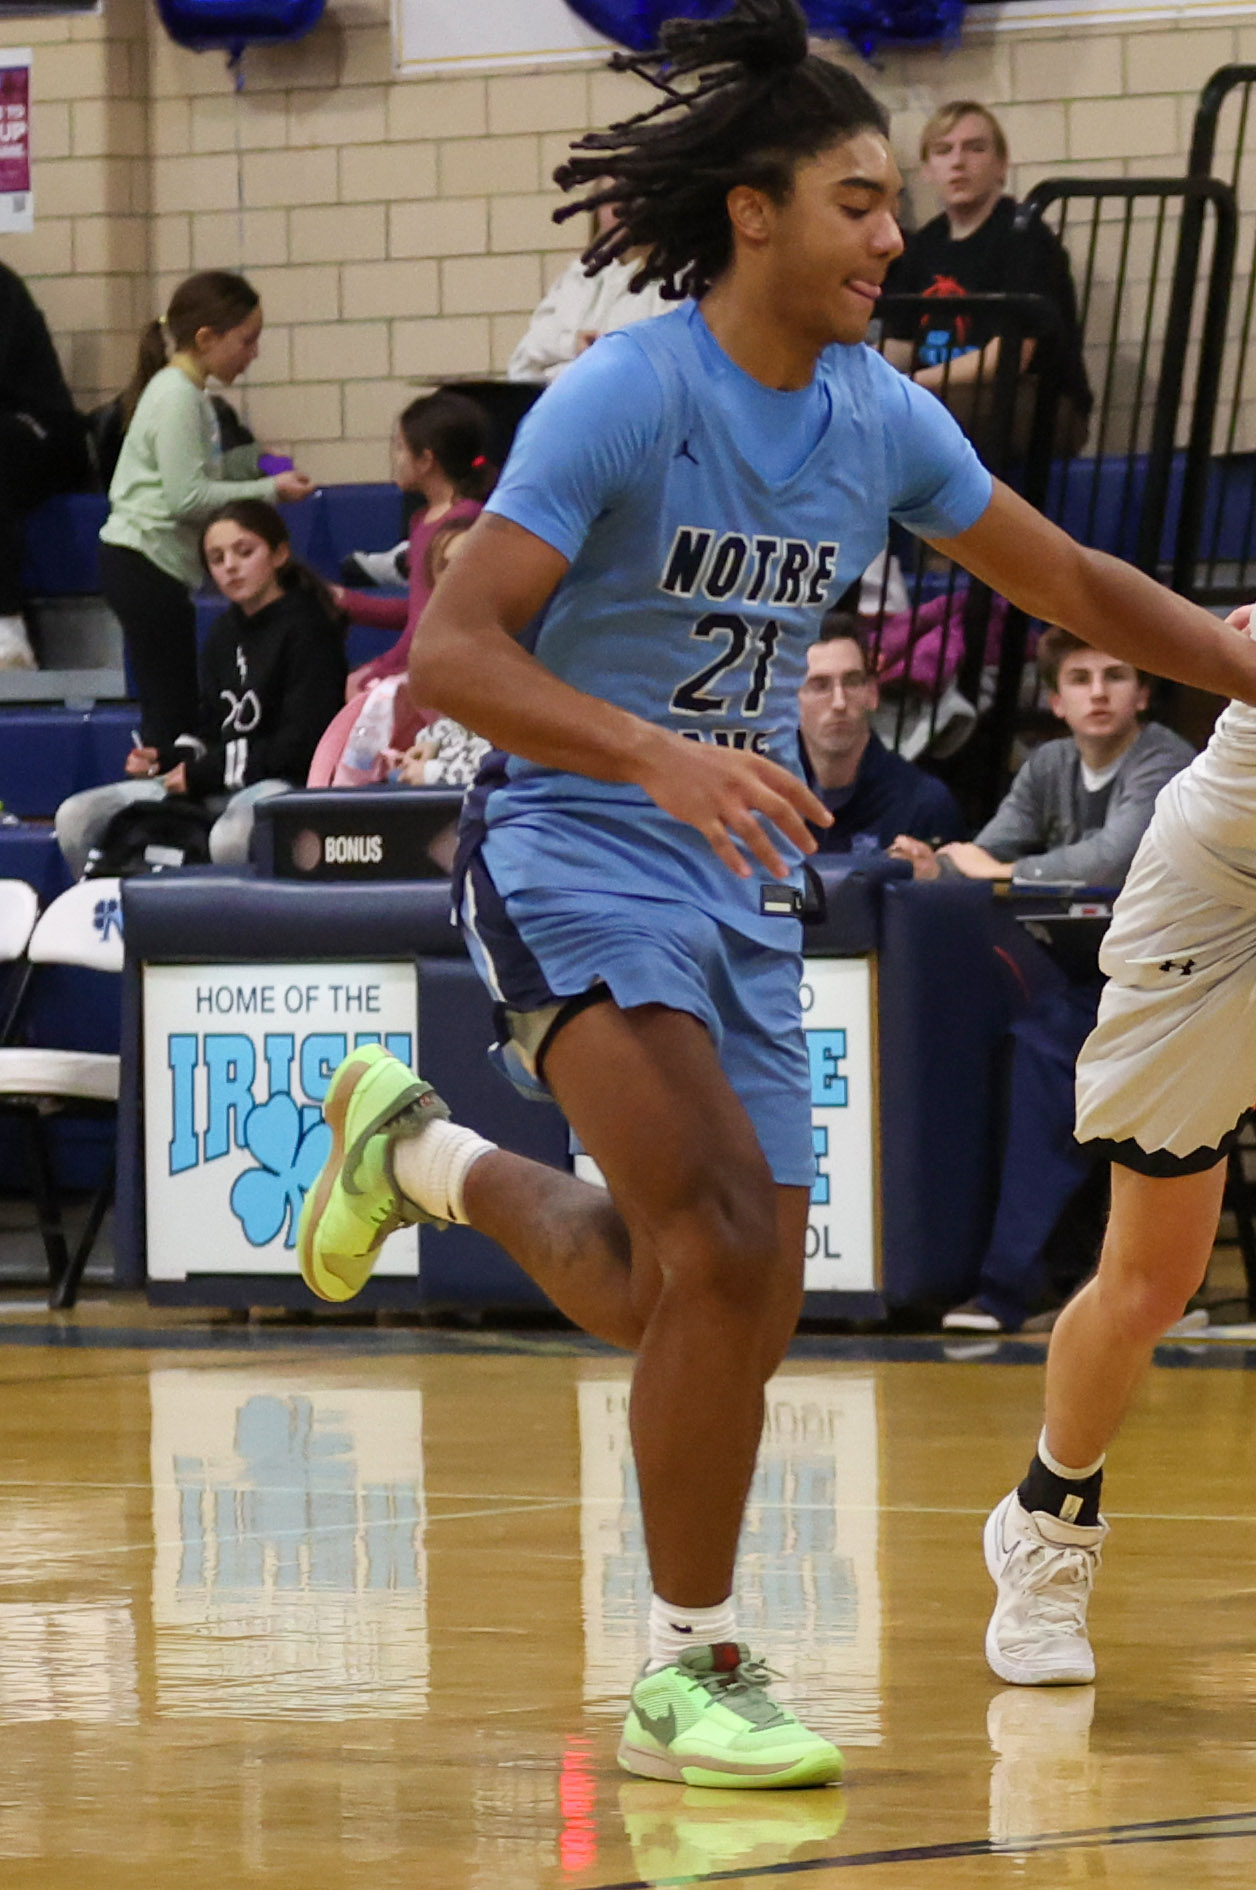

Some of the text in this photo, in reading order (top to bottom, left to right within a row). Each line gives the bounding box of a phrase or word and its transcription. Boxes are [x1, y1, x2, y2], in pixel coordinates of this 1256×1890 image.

[659, 525, 839, 608] NOTRE
[669, 612, 781, 717] 21
[324, 835, 384, 864] BONUS
[196, 984, 381, 1014] HOME OF THE
[168, 1033, 412, 1177] IRIS
